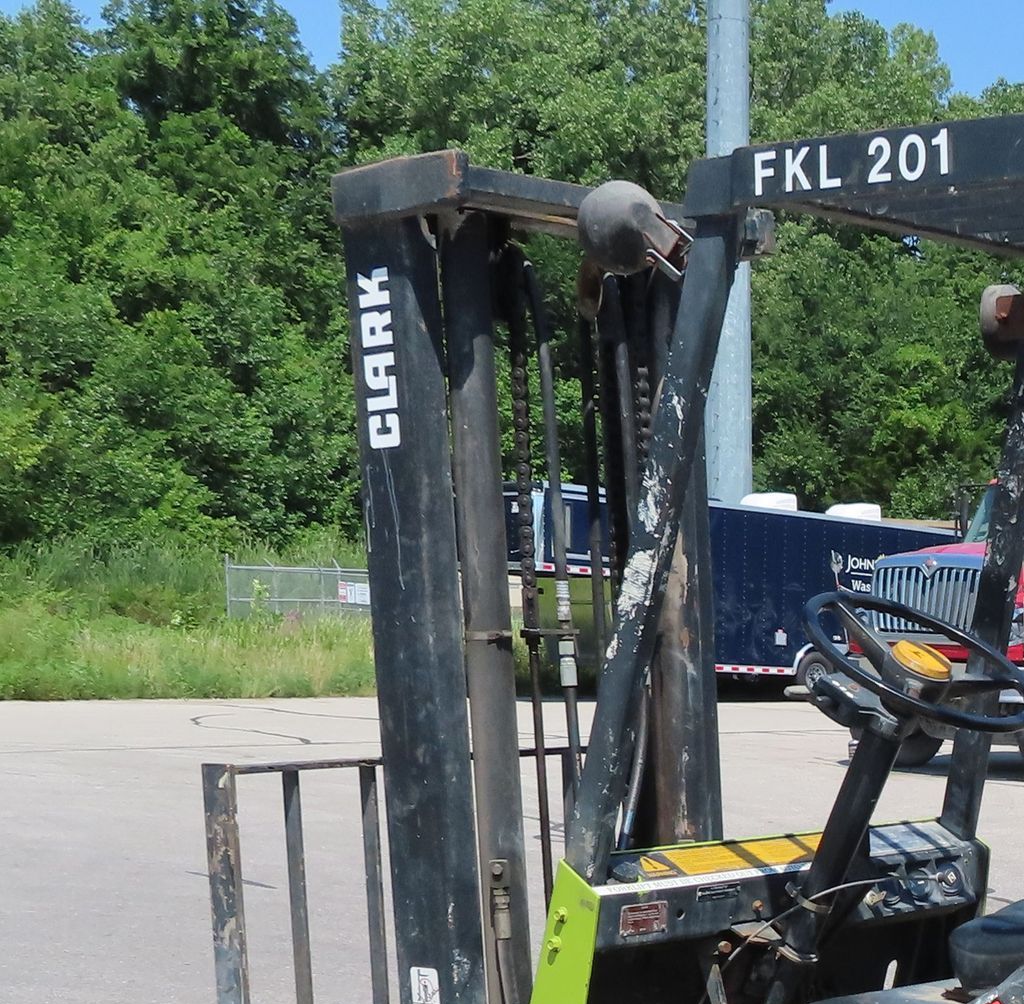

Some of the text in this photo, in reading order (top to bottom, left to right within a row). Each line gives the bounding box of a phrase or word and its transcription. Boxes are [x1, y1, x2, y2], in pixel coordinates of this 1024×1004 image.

[754, 127, 949, 197] FKL 201
[356, 266, 401, 450] CLARK
